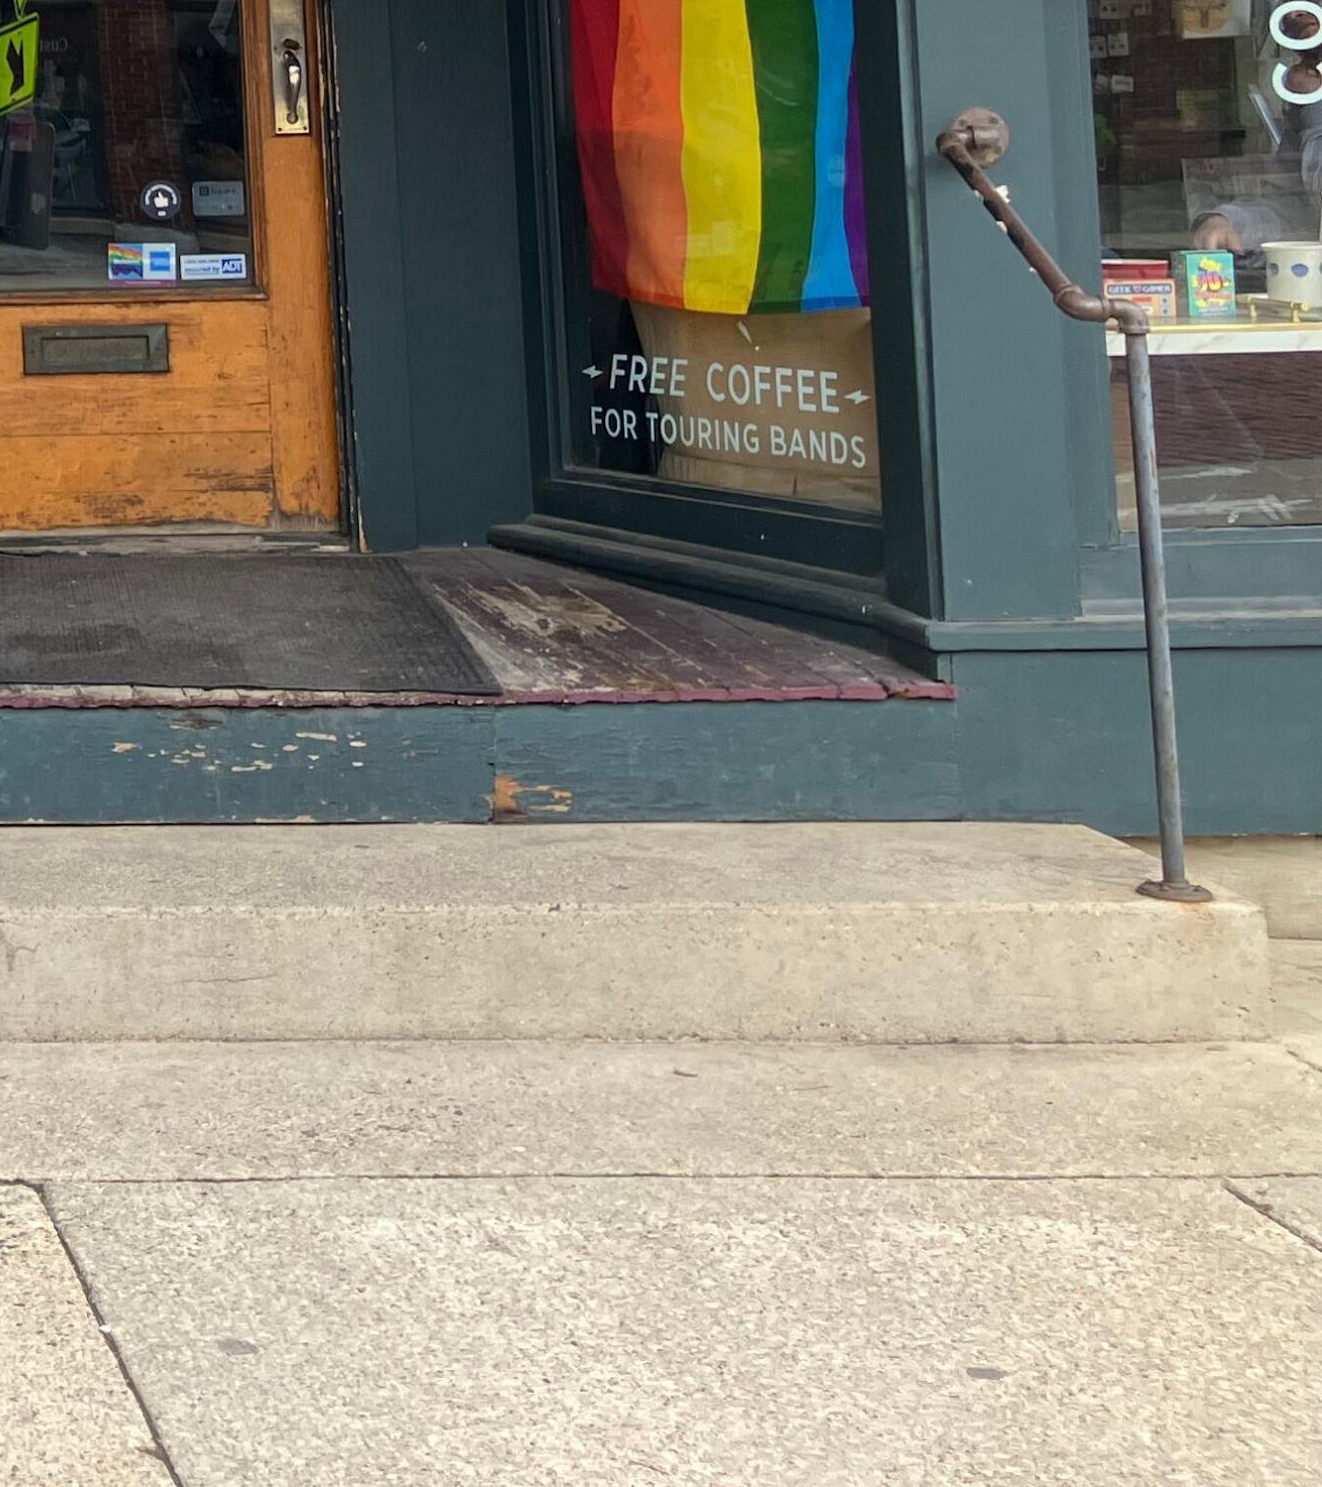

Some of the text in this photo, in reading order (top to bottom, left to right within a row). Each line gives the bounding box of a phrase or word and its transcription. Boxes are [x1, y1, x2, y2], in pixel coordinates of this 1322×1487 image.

[609, 354, 840, 413] FREE COFFEE
[590, 406, 867, 469] FOR TOURING BANDS
